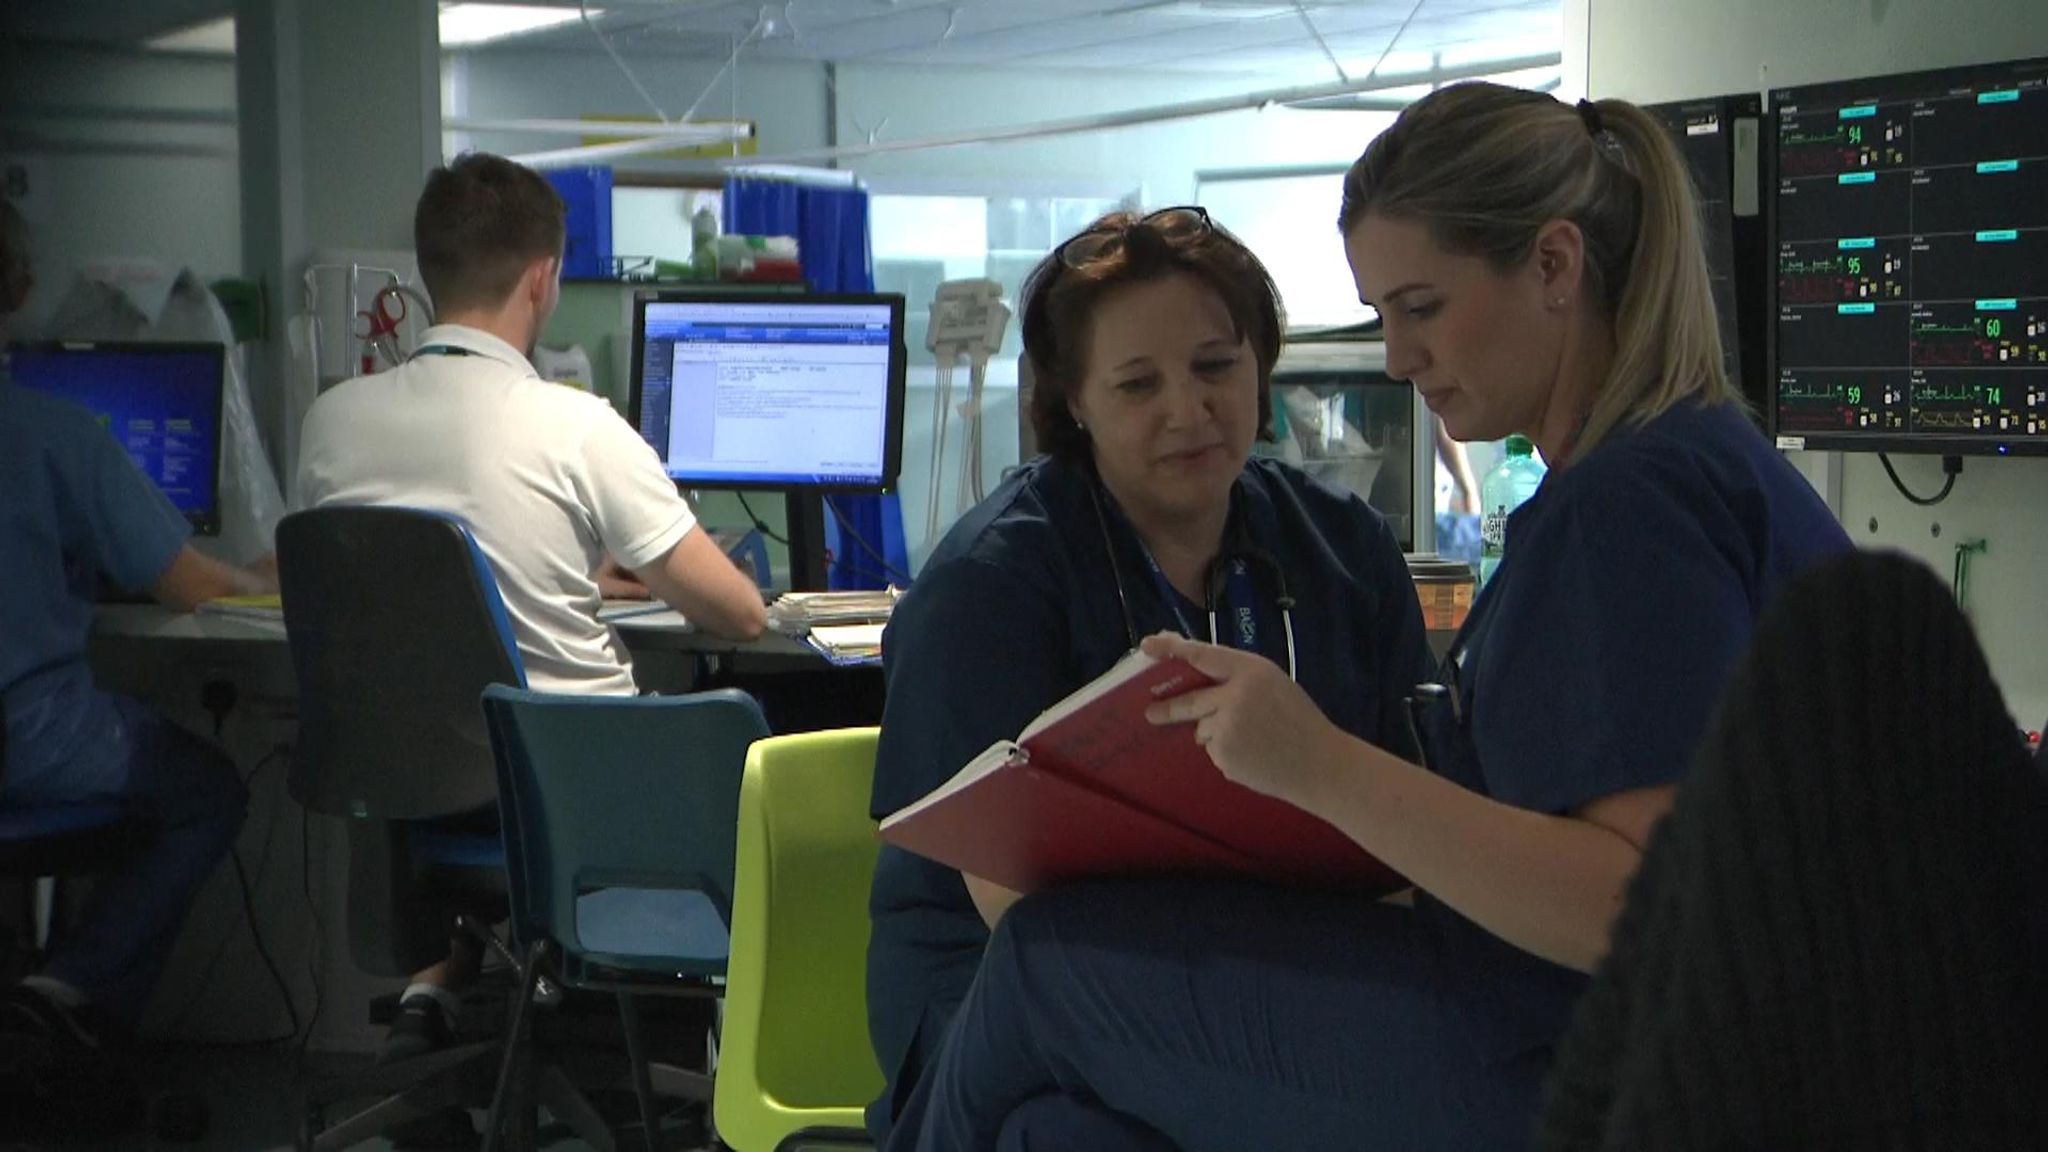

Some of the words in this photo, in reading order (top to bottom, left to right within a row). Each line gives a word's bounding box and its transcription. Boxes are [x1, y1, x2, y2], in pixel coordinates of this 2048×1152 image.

[1848, 125, 1862, 144] 94
[1847, 257, 1861, 274] 95
[1986, 318, 2001, 338] 60
[1847, 386, 1861, 404] 59
[1986, 387, 2001, 406] 74
